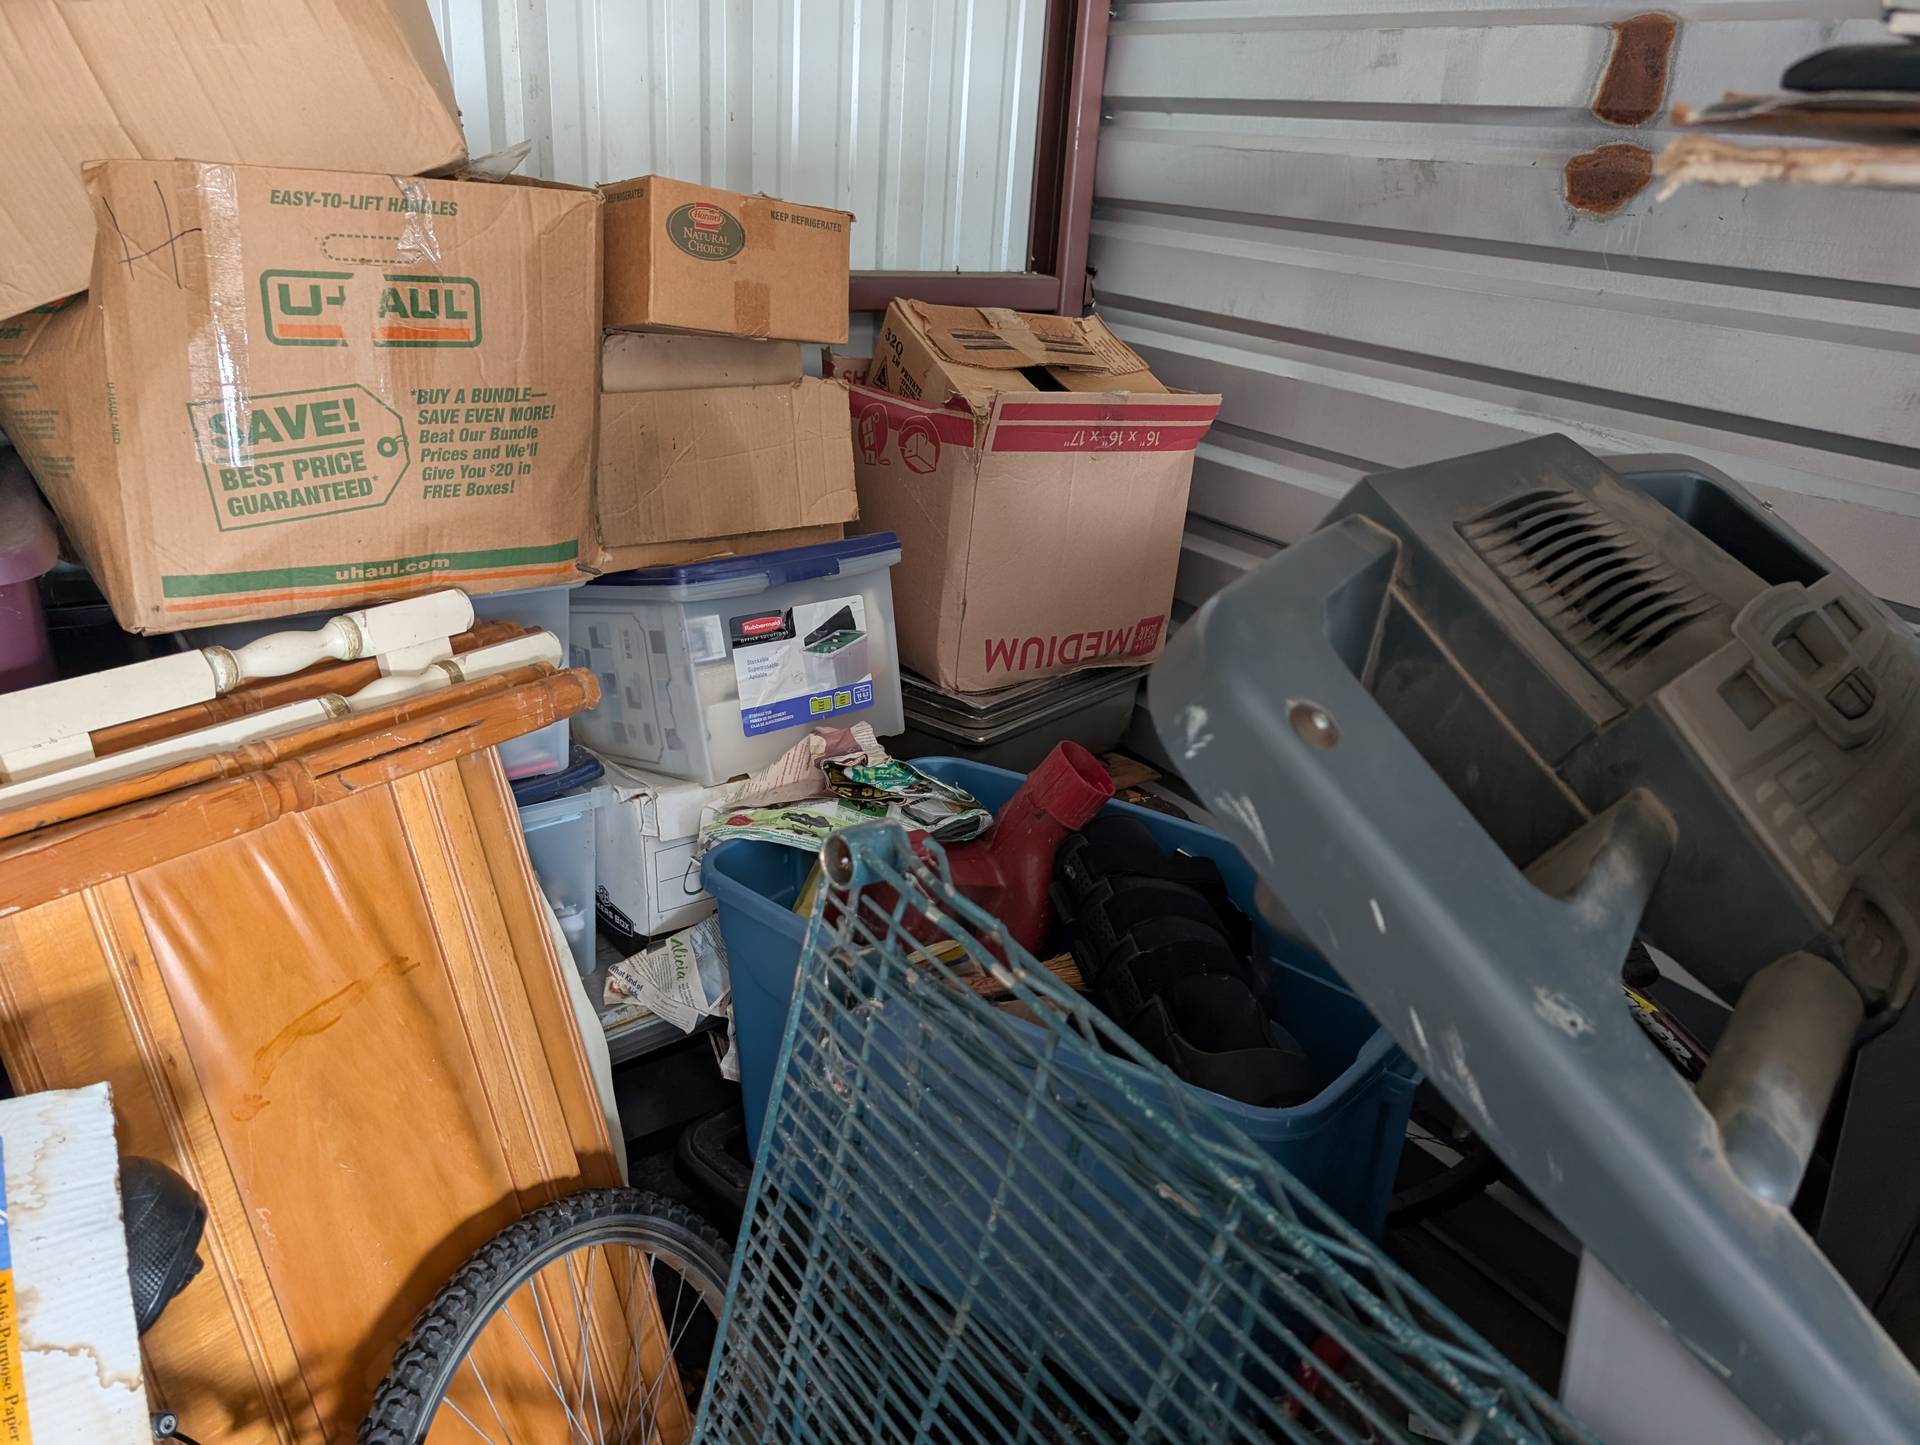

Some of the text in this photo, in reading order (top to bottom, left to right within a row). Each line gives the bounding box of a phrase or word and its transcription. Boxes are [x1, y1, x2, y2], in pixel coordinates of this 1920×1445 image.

[269, 189, 384, 212] EASY-TO-LIFT
[693, 209, 721, 223] Hormel
[770, 210, 842, 233] KEEP REFRIGERATED
[683, 226, 730, 245] NATURAL
[688, 239, 727, 256] CHOICE
[277, 283, 469, 320] U-AUL
[454, 388, 466, 404] A
[208, 397, 361, 450] SAVE!
[418, 404, 556, 425] SAVE EVEN MORE!
[419, 425, 539, 444] Beat Our Bundle
[420, 442, 539, 463] Prices and We'll
[219, 450, 368, 492] BEST PRICE
[422, 461, 532, 481] Give You $20 in
[423, 480, 515, 500] FREE Boxes!
[335, 558, 450, 581] uhaul.com
[744, 619, 782, 632] Rubbermaid
[985, 625, 1134, 673] MEDIUM
[670, 936, 689, 982] Alicia
[625, 974, 638, 987] Kind
[3, 1393, 20, 1442] Paper
